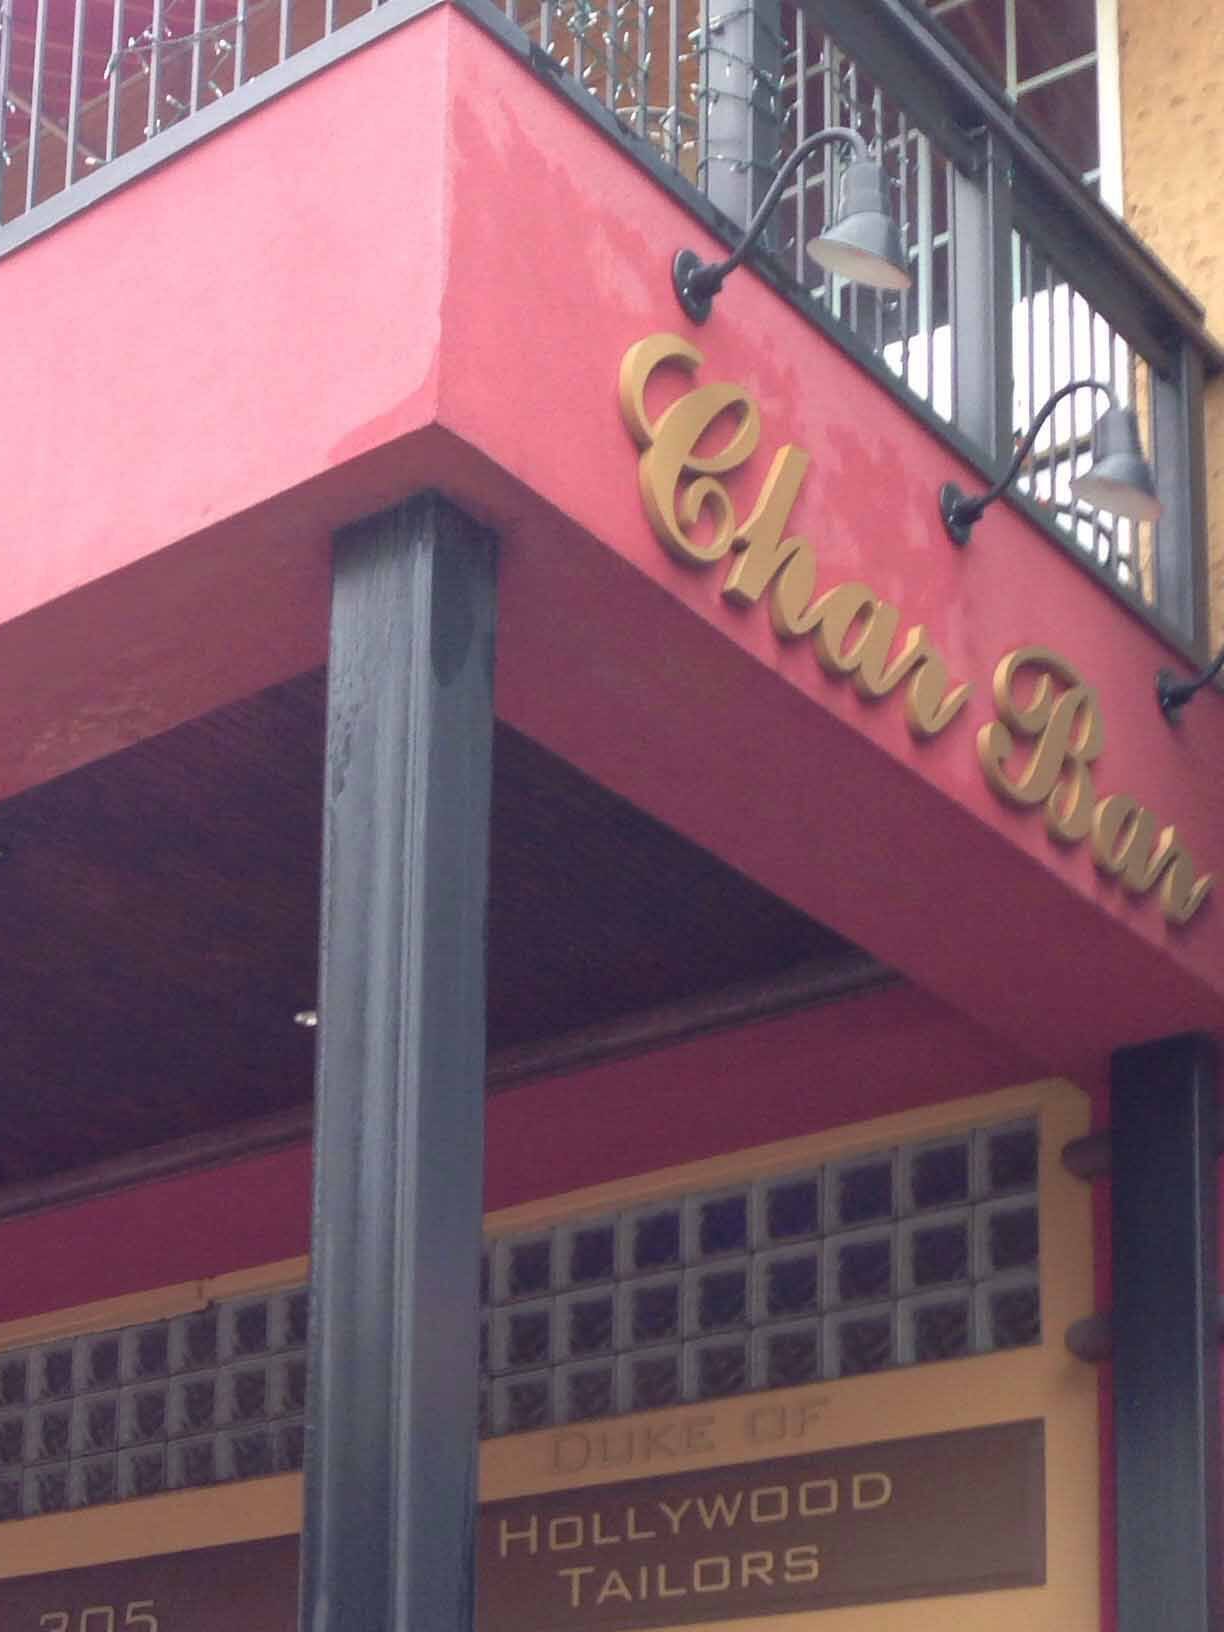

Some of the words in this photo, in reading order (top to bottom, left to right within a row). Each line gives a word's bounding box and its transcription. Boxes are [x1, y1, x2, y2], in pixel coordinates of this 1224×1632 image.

[619, 332, 975, 736] Char
[977, 646, 1214, 925] Bar
[552, 1415, 715, 1472] DUKE
[747, 1397, 828, 1442] OF
[499, 1471, 893, 1557] HOLLYWOOD
[559, 1545, 821, 1607] TAILORS
